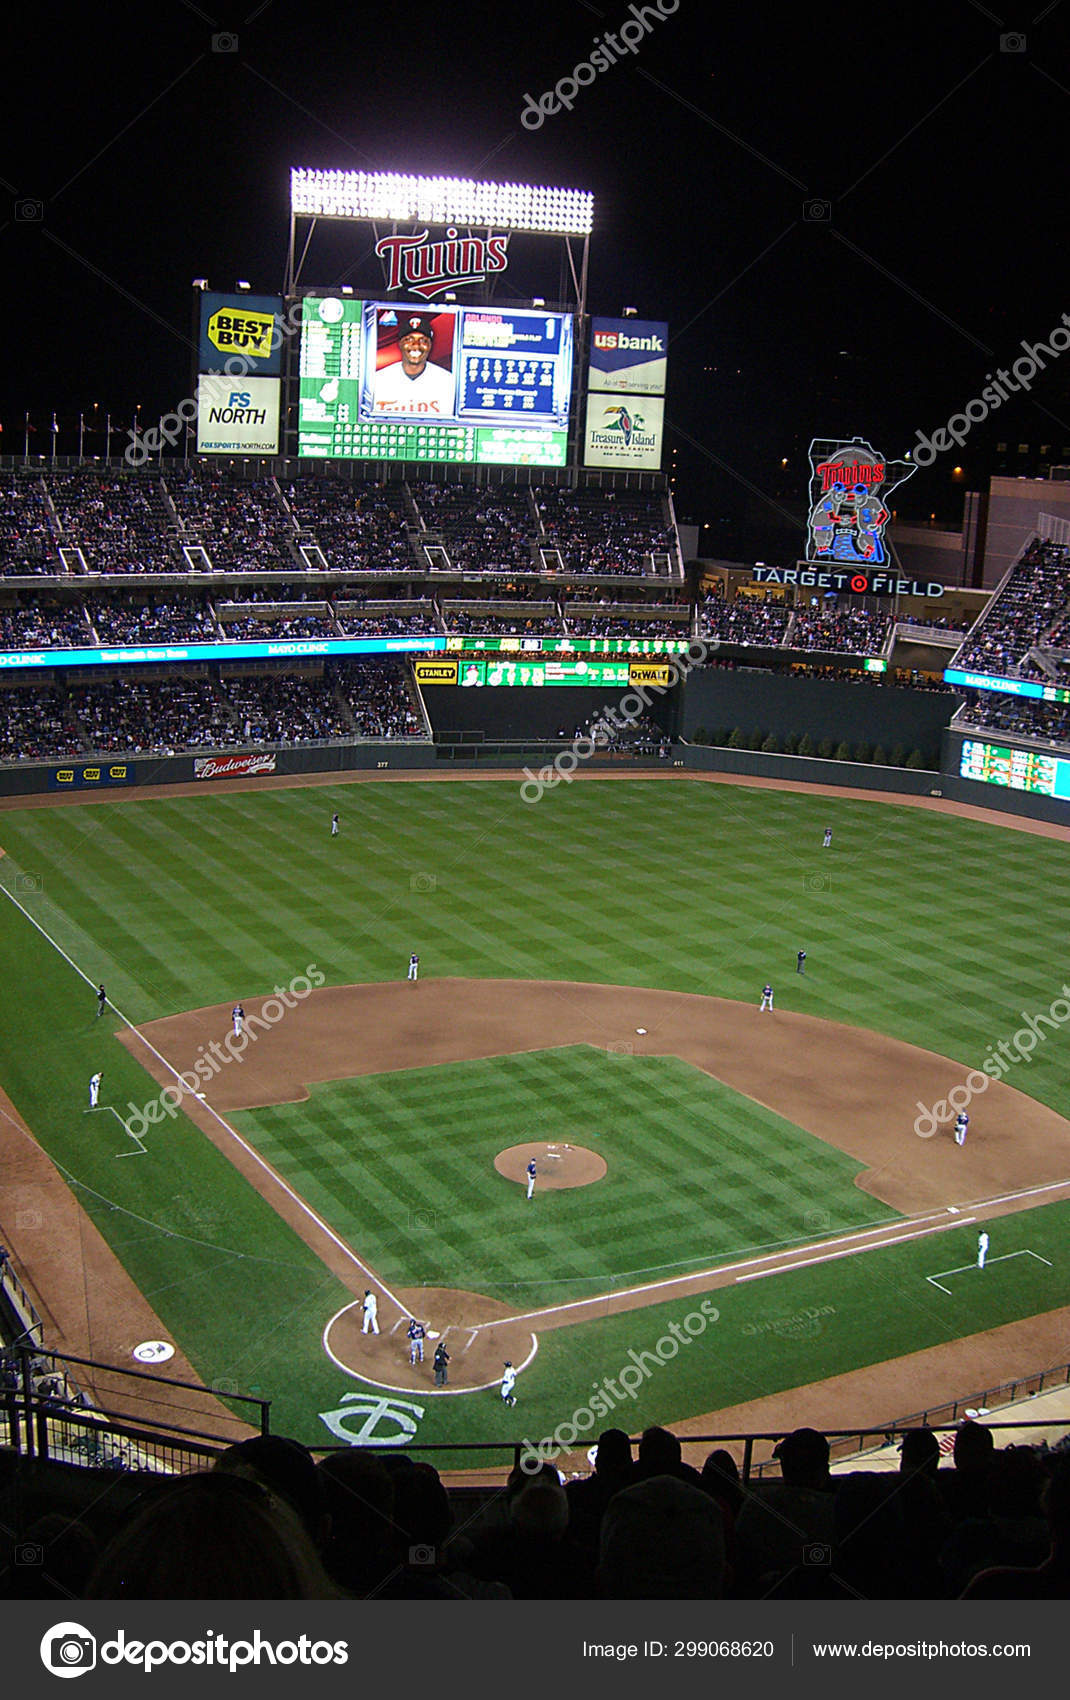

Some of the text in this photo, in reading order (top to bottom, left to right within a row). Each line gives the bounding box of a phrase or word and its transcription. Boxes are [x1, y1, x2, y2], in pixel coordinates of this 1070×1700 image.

[375, 228, 508, 292] Twins
[217, 315, 272, 335] BEST
[217, 331, 266, 350] BUY
[228, 392, 251, 408] FS
[209, 408, 266, 424] NORTH
[591, 431, 656, 446] Treasure Island
[816, 460, 884, 491] Twins
[752, 567, 944, 598] TARGET FIELD
[268, 643, 329, 655] MAYO CLINIC
[8, 654, 46, 665] CLINIC
[418, 668, 454, 678] STANLEY
[991, 680, 1022, 694] CLINIC
[201, 753, 276, 778] Budweiser
